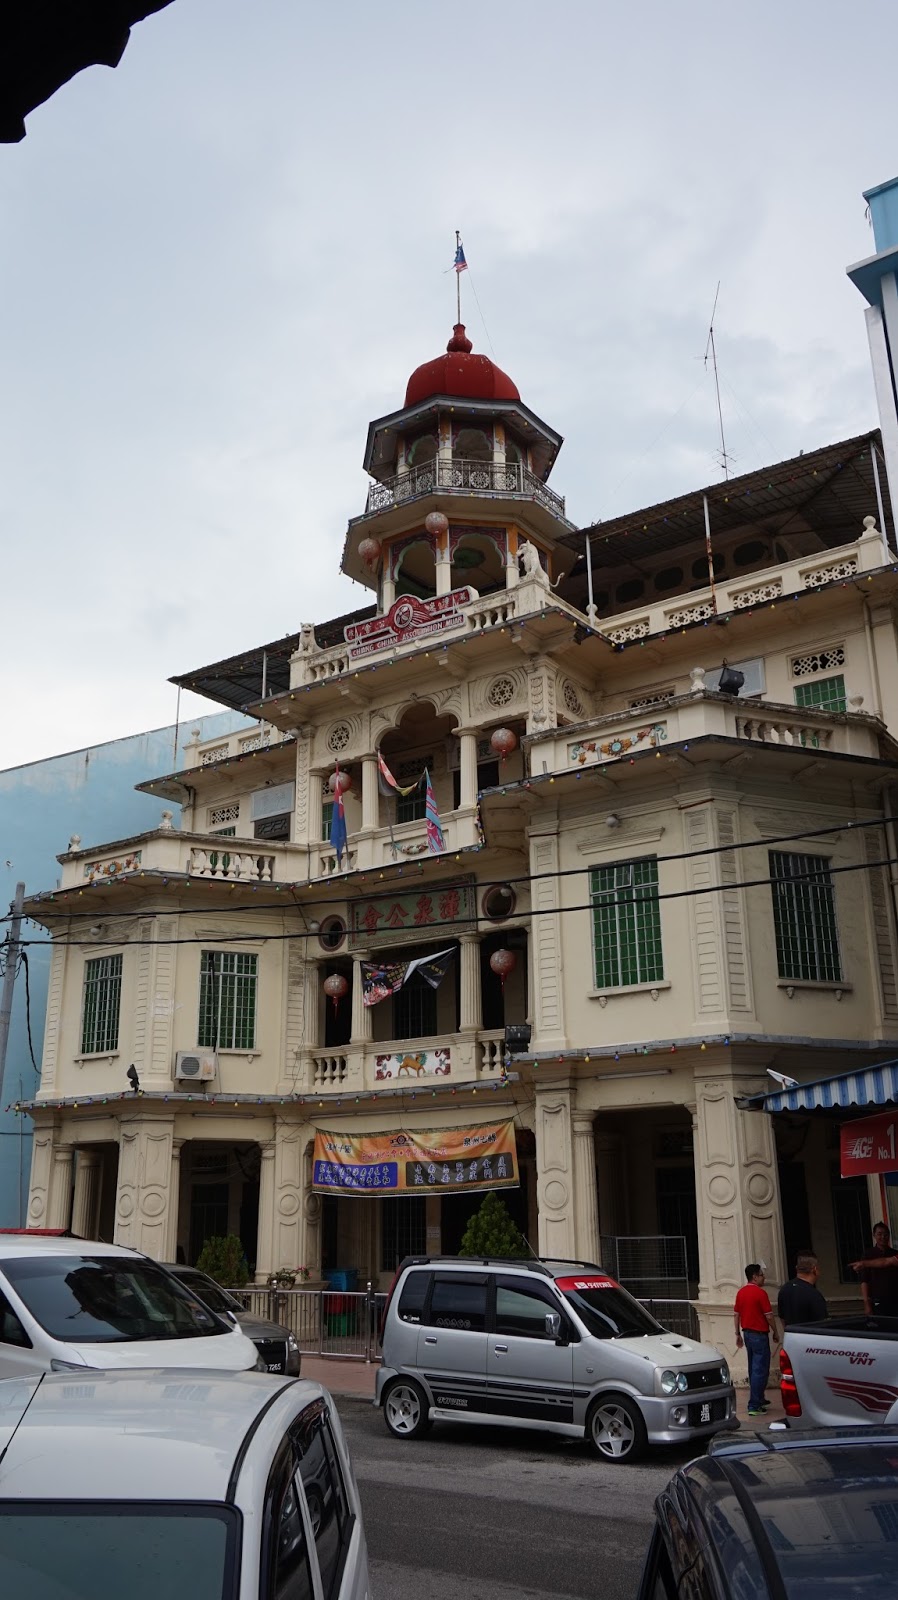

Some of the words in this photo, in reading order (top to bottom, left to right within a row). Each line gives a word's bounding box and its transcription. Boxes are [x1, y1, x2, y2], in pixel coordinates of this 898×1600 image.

[445, 616, 463, 627] MUAR
[852, 1137, 868, 1159] 4G
[805, 1347, 870, 1358] INTERCOOLER
[849, 1357, 876, 1366] VNT
[268, 1363, 282, 1372] 7265
